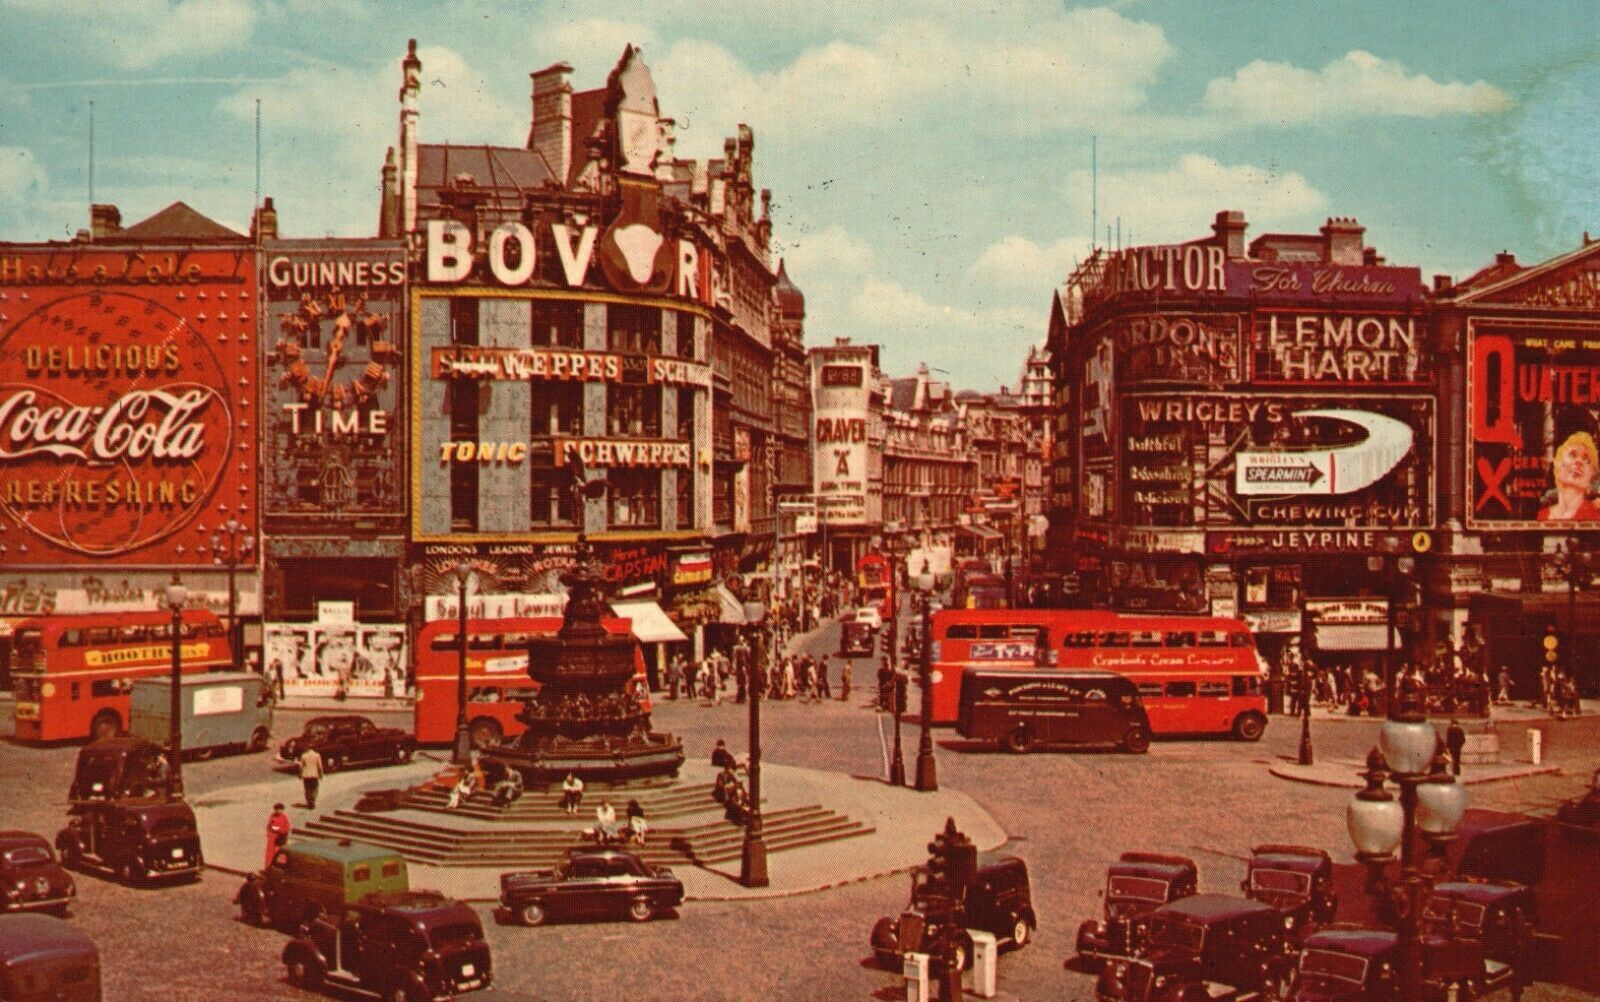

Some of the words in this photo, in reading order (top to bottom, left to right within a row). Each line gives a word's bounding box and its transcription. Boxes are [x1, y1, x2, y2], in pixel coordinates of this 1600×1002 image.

[269, 257, 404, 287] GUINNESS
[1312, 268, 1396, 293] Charm
[1272, 316, 1415, 348] LEMON
[26, 344, 179, 370] DELICIOUS
[1284, 351, 1399, 380] HART
[283, 403, 388, 434] TIME
[1139, 401, 1284, 422] WRIGLEY'S
[0, 390, 213, 459] Coca-Cola
[816, 418, 866, 443] CRAVEN
[440, 442, 529, 462] TONIC
[1247, 470, 1314, 480] SPEARMINT
[1475, 456, 1513, 513] X
[7, 480, 196, 504] REFRESHING
[489, 545, 533, 554] LEADING
[1272, 533, 1374, 548] JEYPINE
[604, 556, 668, 581] CAPSTAN
